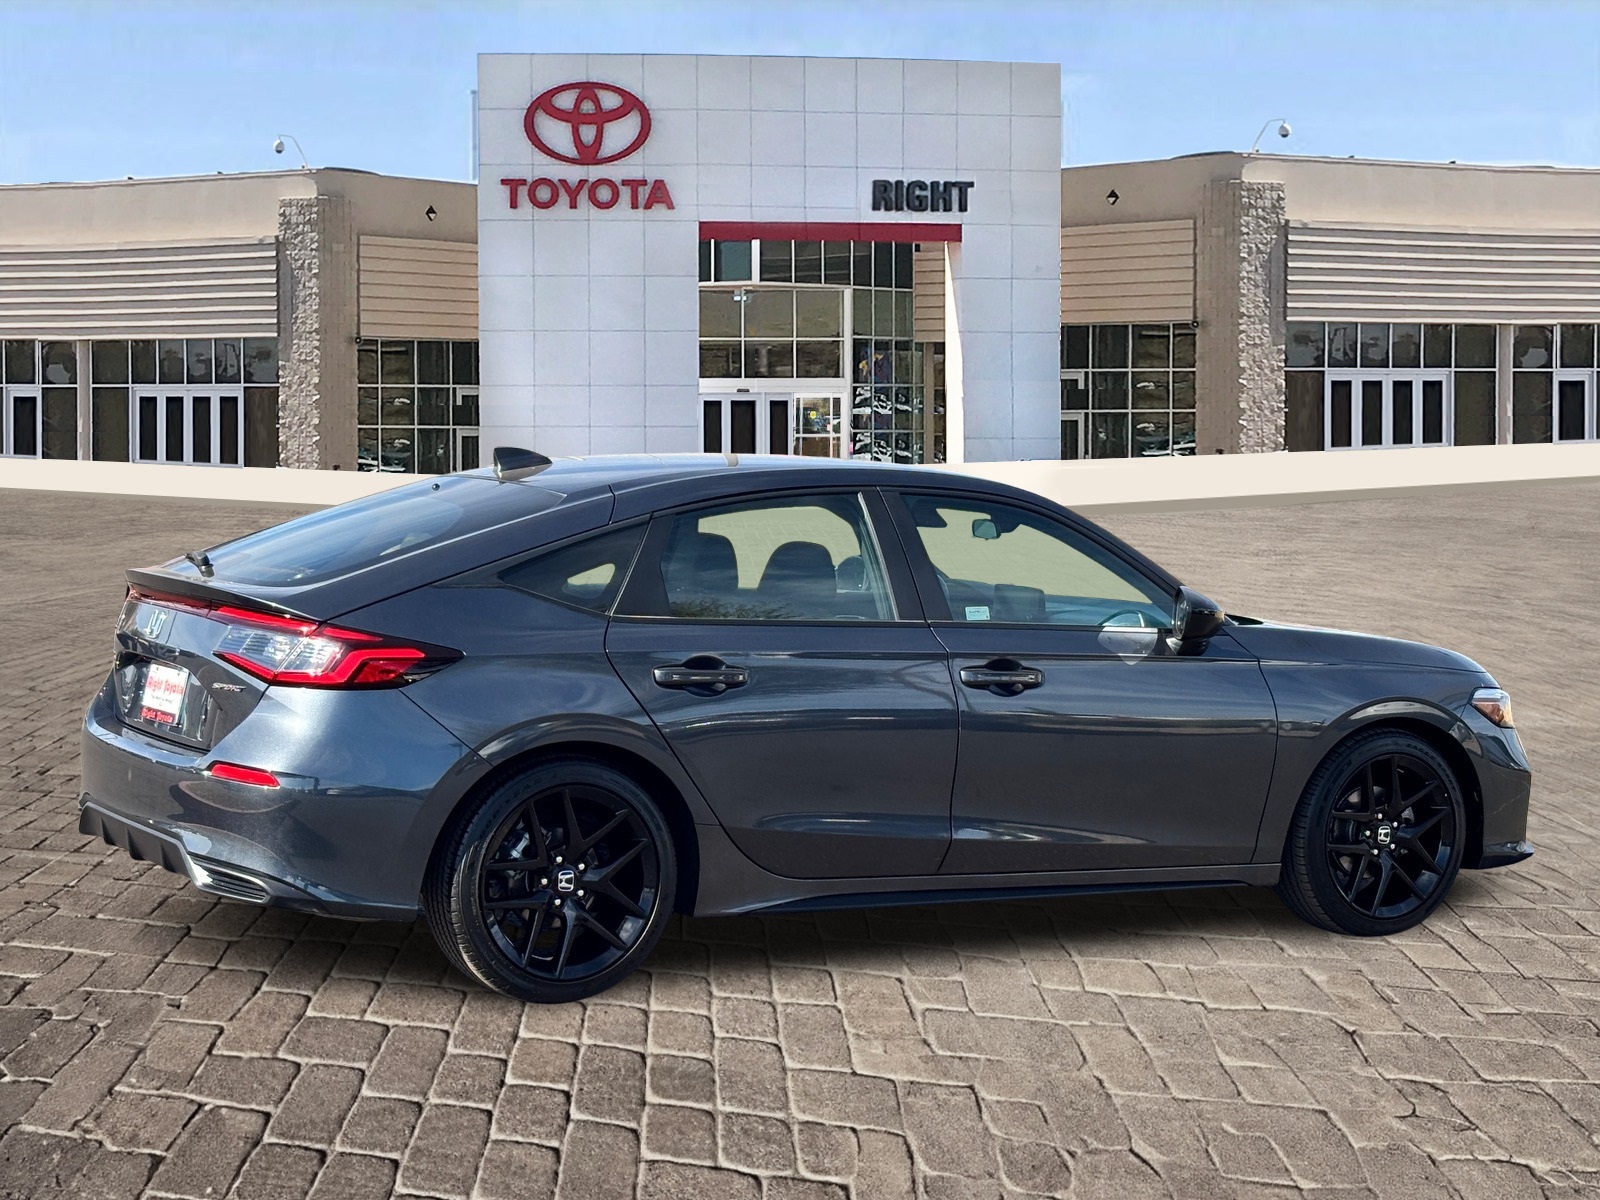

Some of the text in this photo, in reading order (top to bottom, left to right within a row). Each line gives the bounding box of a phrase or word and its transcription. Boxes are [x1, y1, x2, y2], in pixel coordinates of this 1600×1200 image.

[500, 178, 675, 210] TOYOTA
[871, 179, 975, 213] RIGHT
[146, 676, 185, 696] Right Toyota
